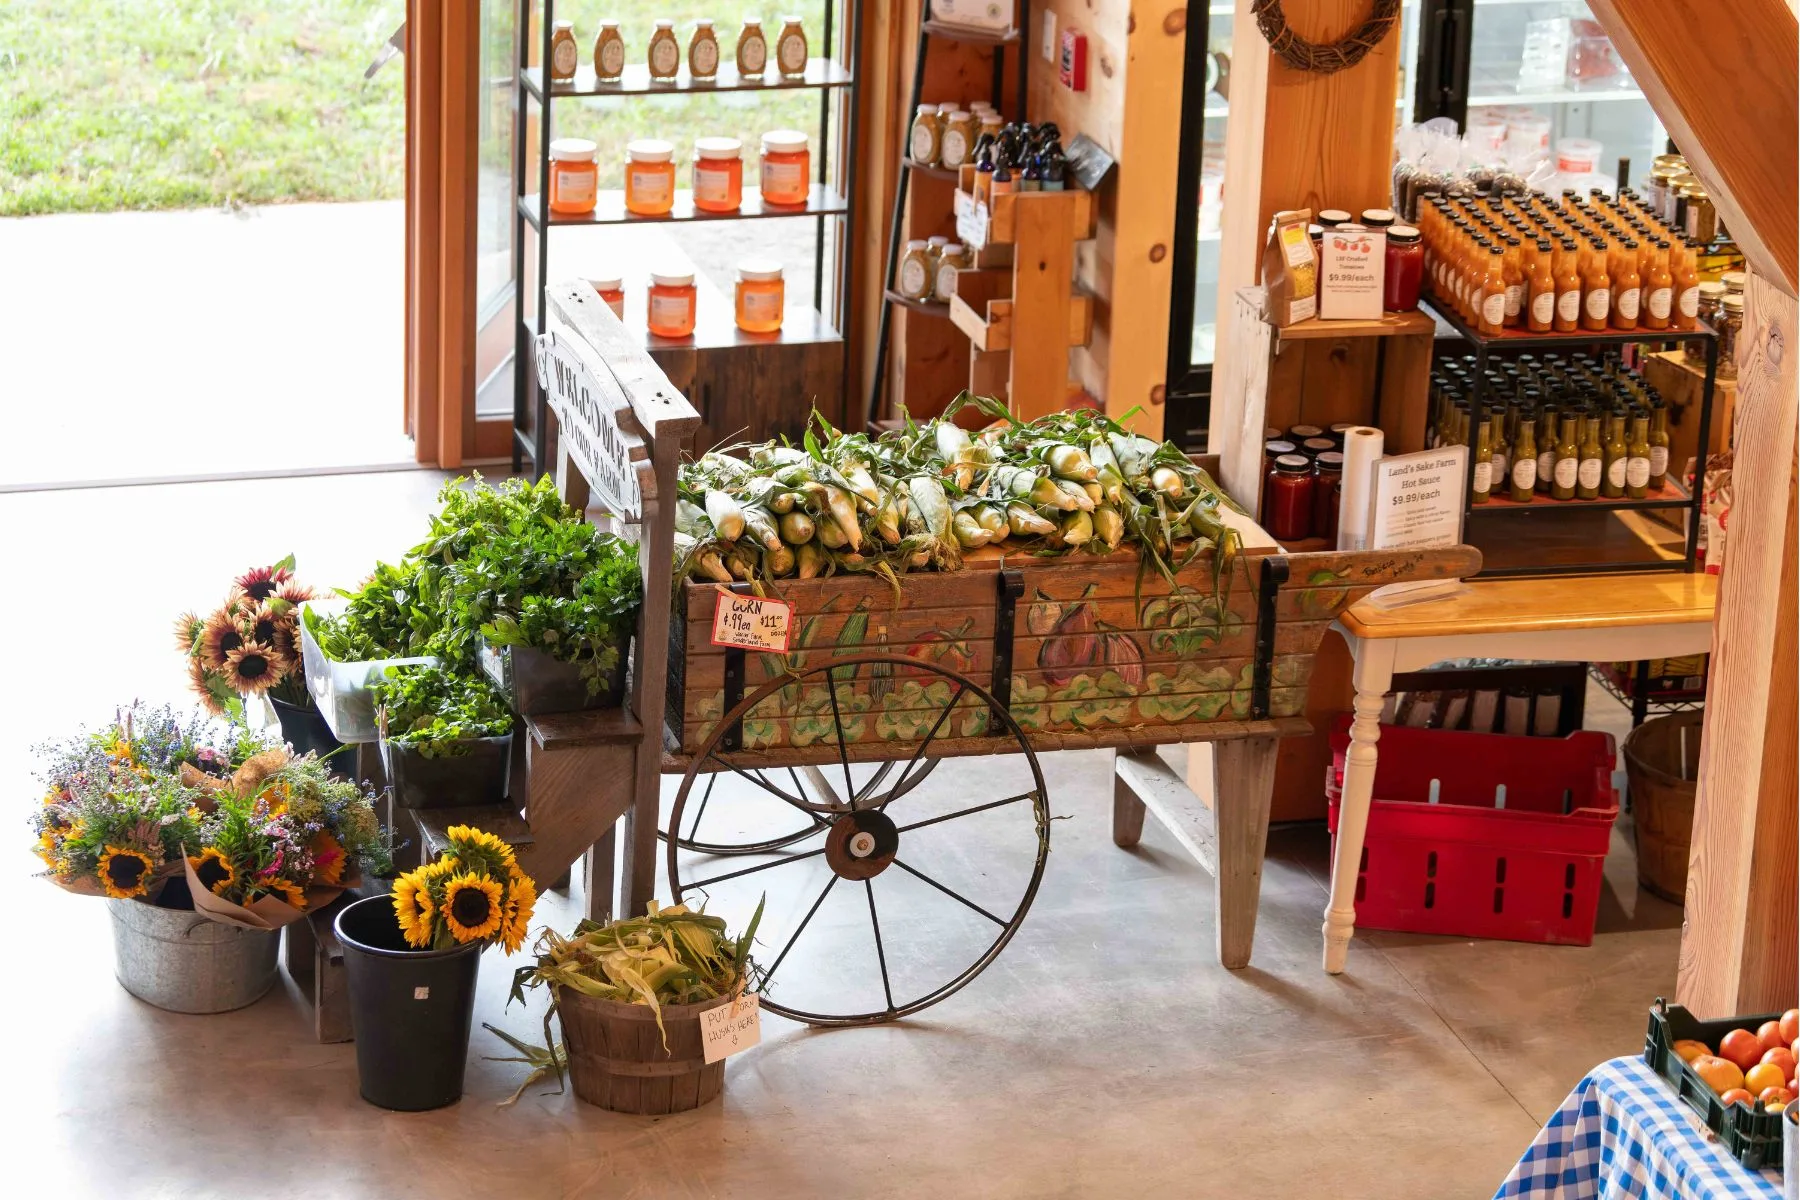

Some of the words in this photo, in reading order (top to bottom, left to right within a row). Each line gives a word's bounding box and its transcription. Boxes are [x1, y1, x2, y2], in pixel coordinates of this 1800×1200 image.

[1328, 273, 1375, 282] $9.99/each
[554, 356, 626, 482] WELCOME
[593, 449, 622, 504] FARM
[1388, 464, 1414, 477] Land's
[1416, 461, 1434, 472] Sake
[1436, 458, 1456, 469] Farm
[1401, 480, 1417, 489] Hot
[1418, 476, 1441, 485] Sauce
[1392, 489, 1441, 506] $9.99/each
[707, 1007, 727, 1027] PUT
[737, 1000, 754, 1012] ORN
